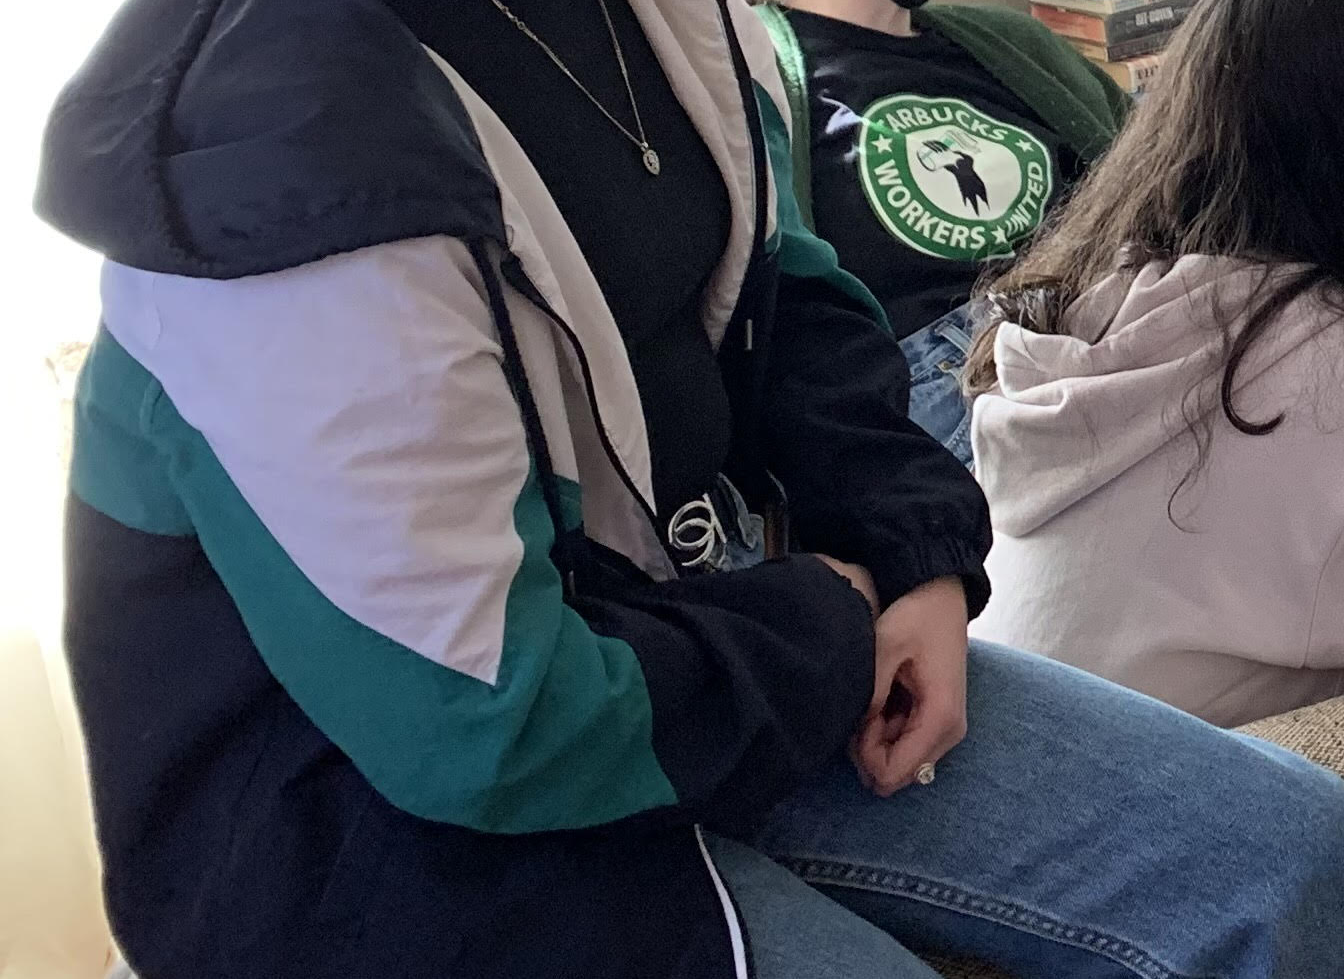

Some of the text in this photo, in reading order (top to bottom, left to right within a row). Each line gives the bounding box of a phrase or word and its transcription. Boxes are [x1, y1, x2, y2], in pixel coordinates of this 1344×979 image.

[885, 106, 1009, 142] ARBUCKS
[873, 158, 986, 250] WORKERS
[1005, 160, 1044, 237] UNITED
